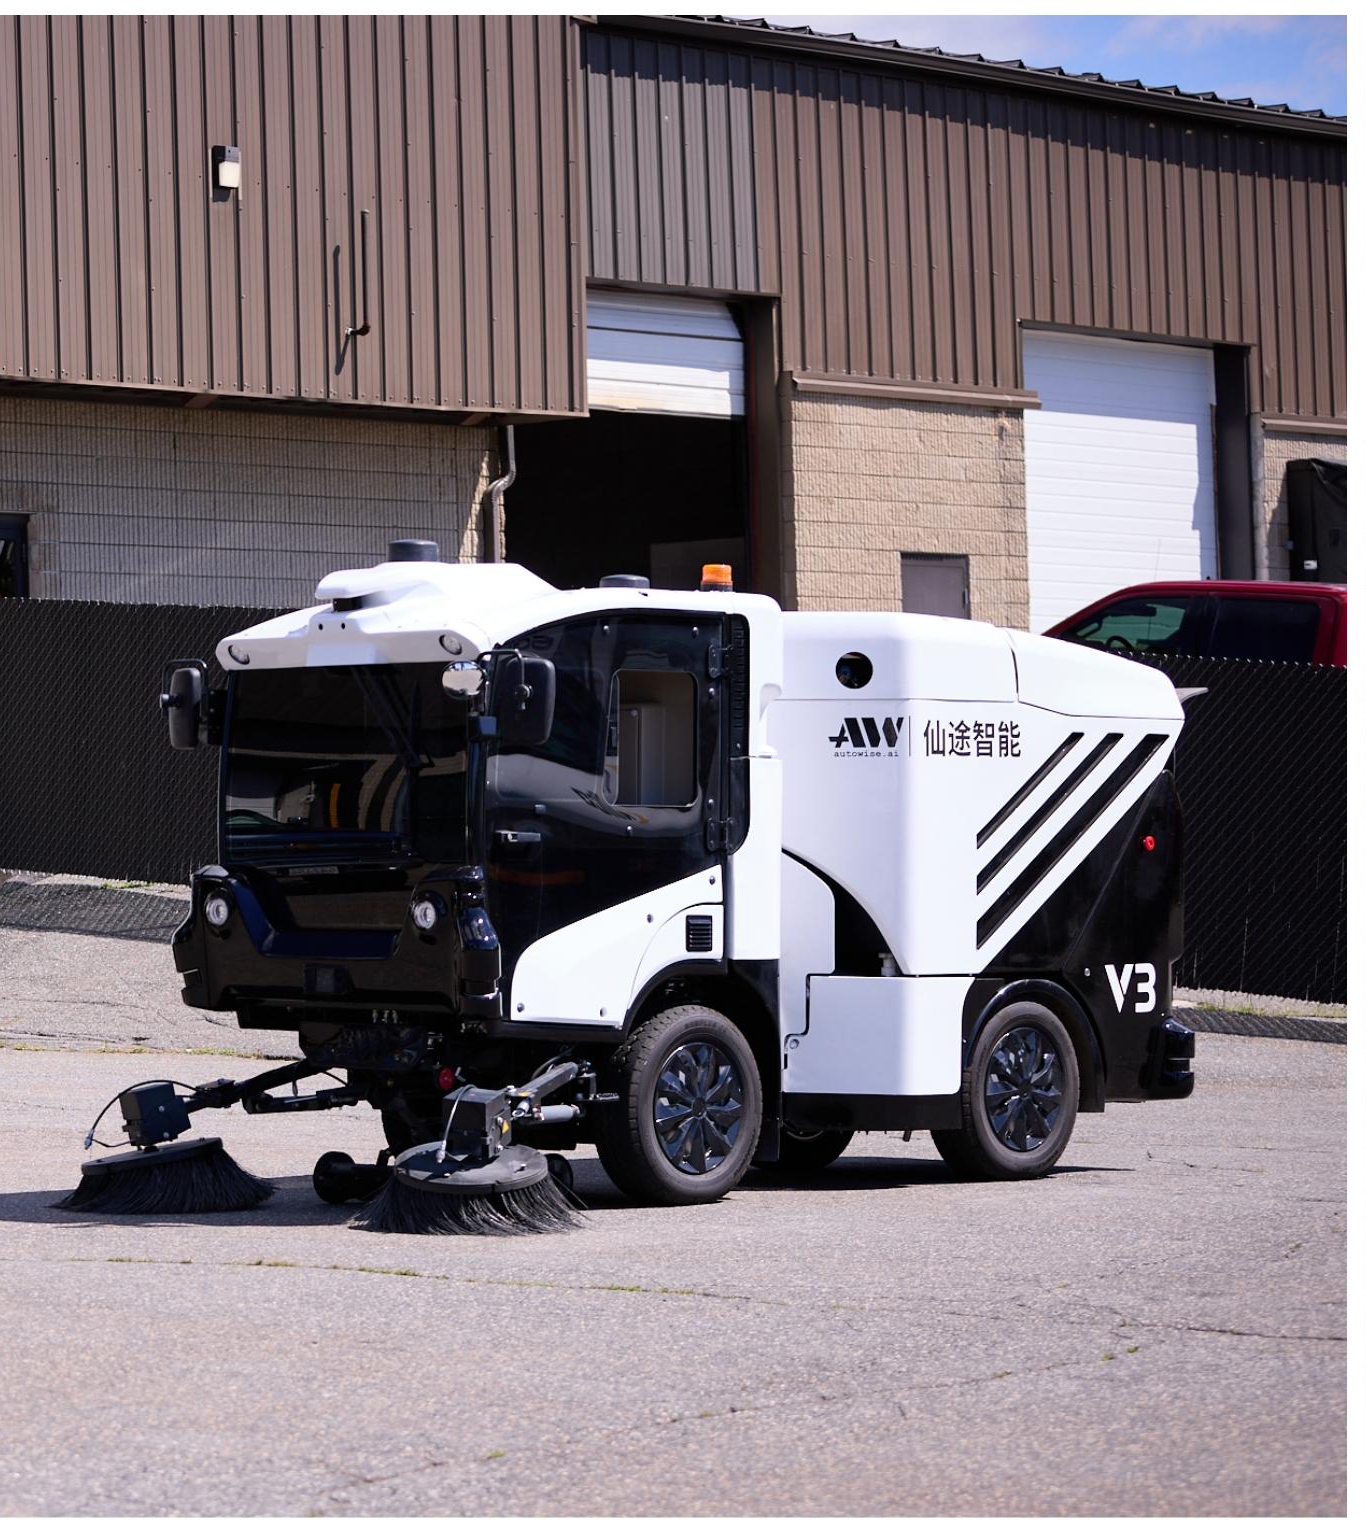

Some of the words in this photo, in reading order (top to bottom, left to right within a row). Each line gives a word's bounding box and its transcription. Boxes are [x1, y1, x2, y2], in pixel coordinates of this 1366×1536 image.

[828, 717, 904, 749] AW
[923, 720, 1021, 758] 仙途智能
[833, 750, 899, 758] autowise.ai
[1104, 962, 1157, 1014] V3
